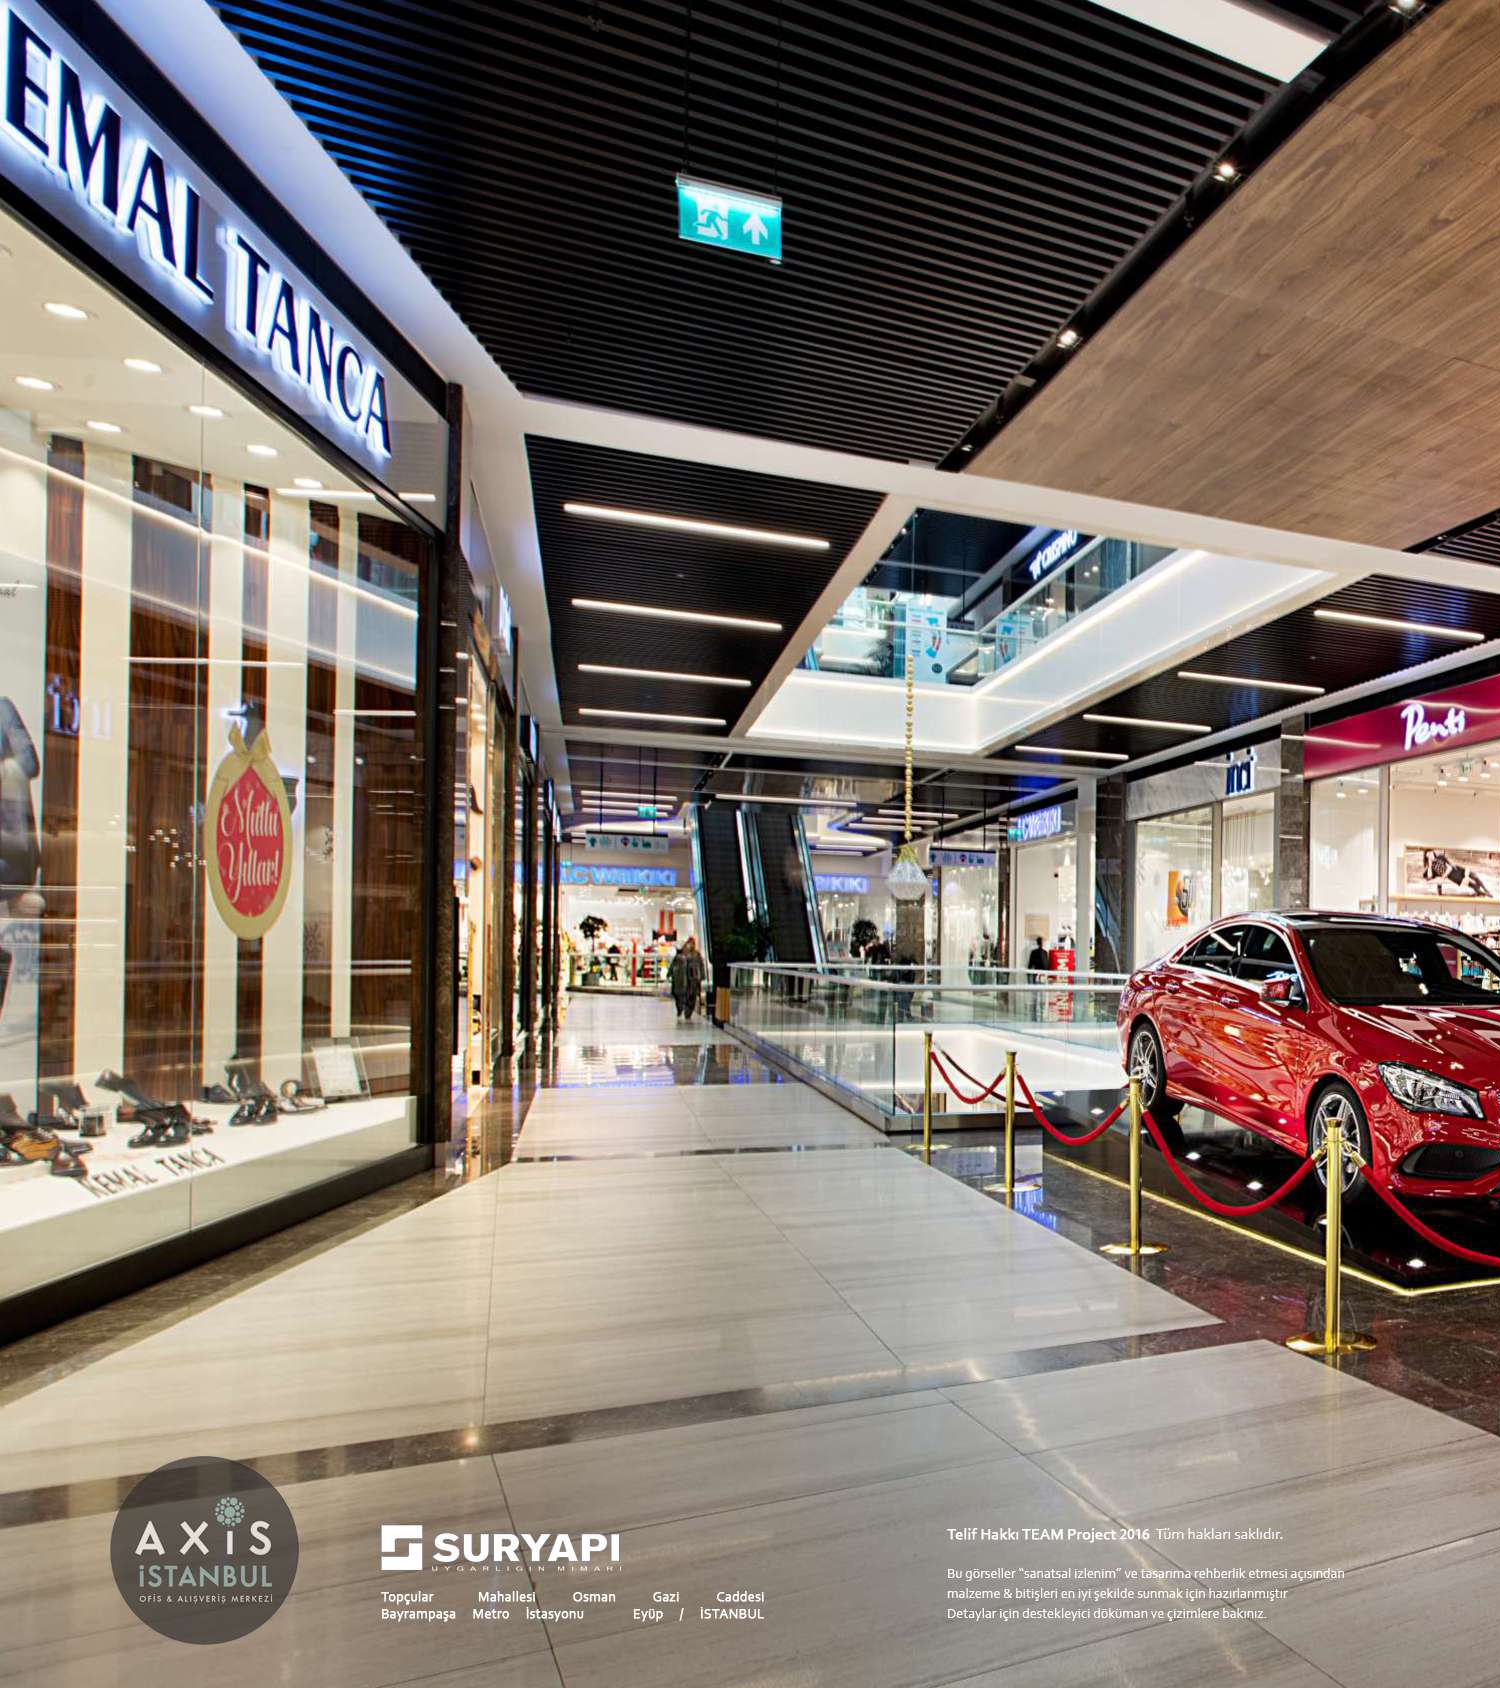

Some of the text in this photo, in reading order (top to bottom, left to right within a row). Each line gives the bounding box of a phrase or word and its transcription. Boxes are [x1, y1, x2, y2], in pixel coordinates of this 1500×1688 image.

[225, 224, 392, 458] TANCA
[1400, 703, 1466, 752] Penti
[155, 1147, 226, 1177] TANCA
